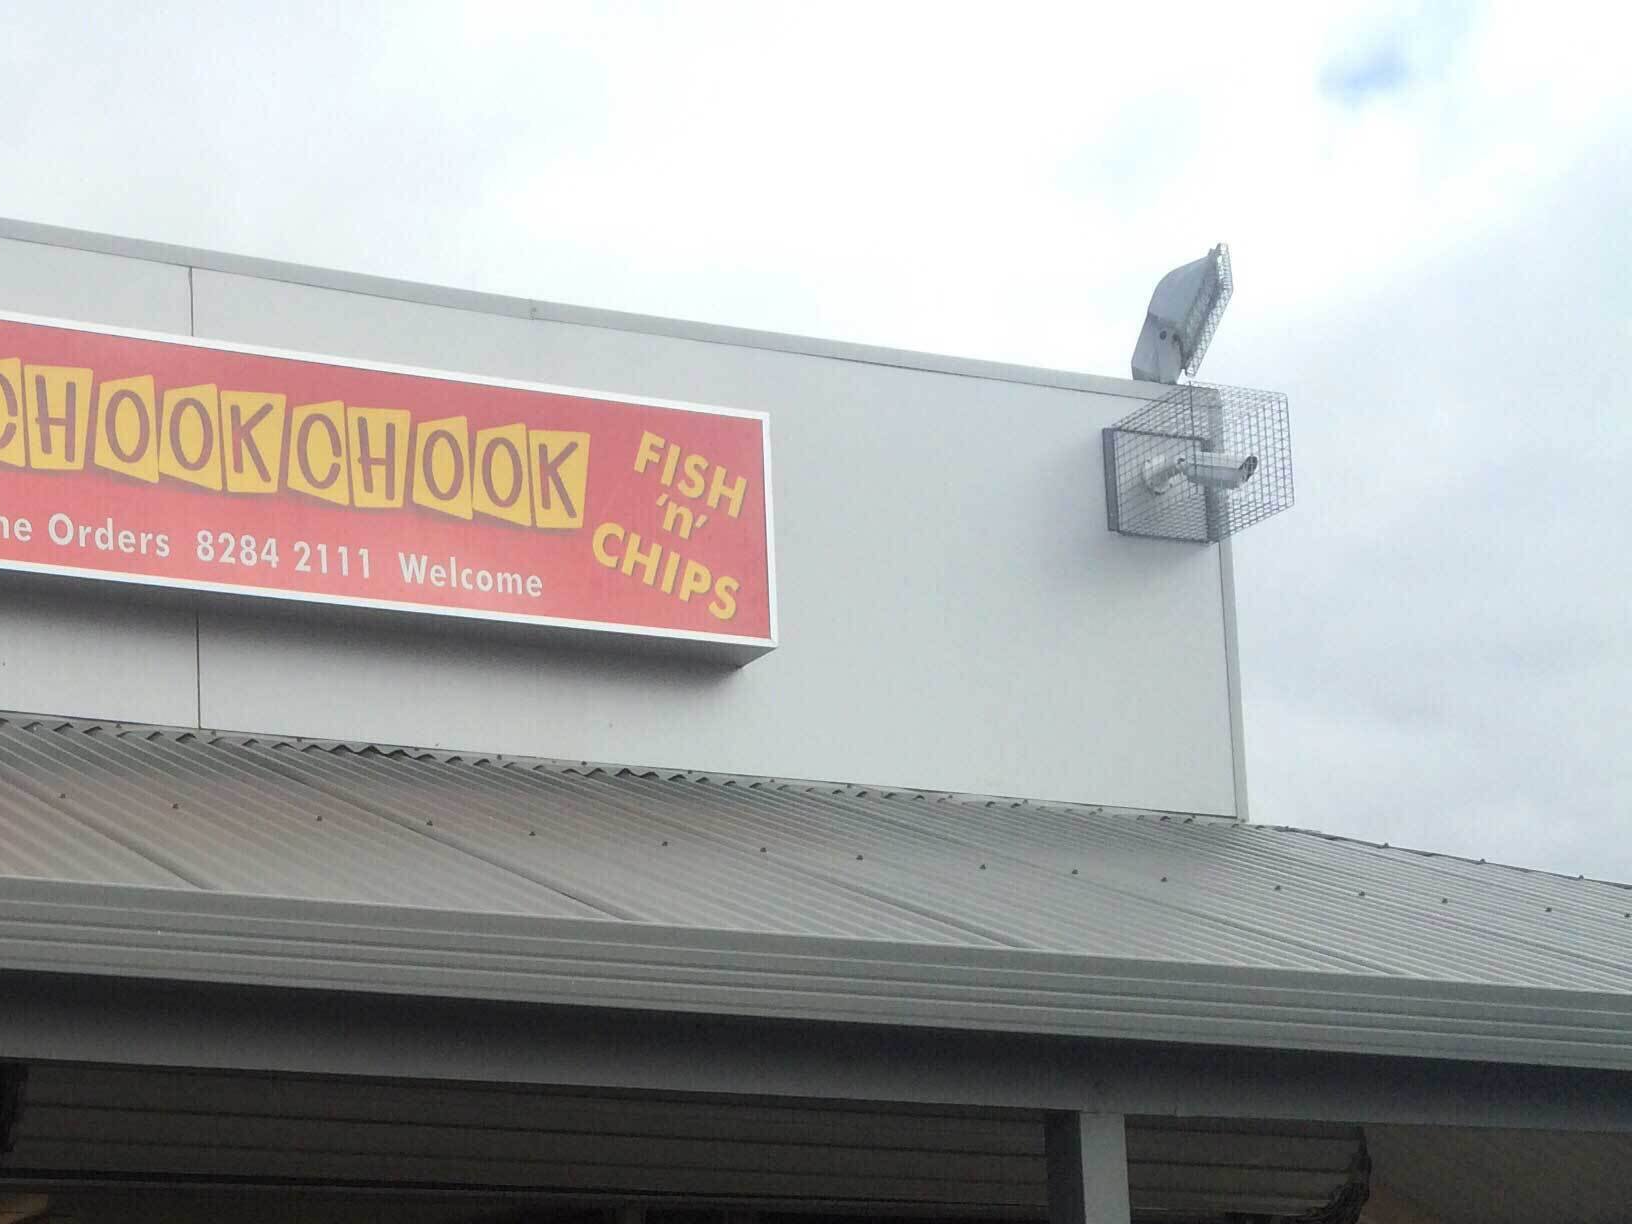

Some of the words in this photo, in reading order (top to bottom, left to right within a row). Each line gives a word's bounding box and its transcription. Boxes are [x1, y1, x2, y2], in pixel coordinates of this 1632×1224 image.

[632, 429, 749, 519] FISH
[48, 512, 171, 558] Orders
[195, 530, 280, 569] 8284
[294, 540, 370, 579] 2111
[398, 551, 544, 598] Welcome
[591, 522, 742, 622] CHIPS
